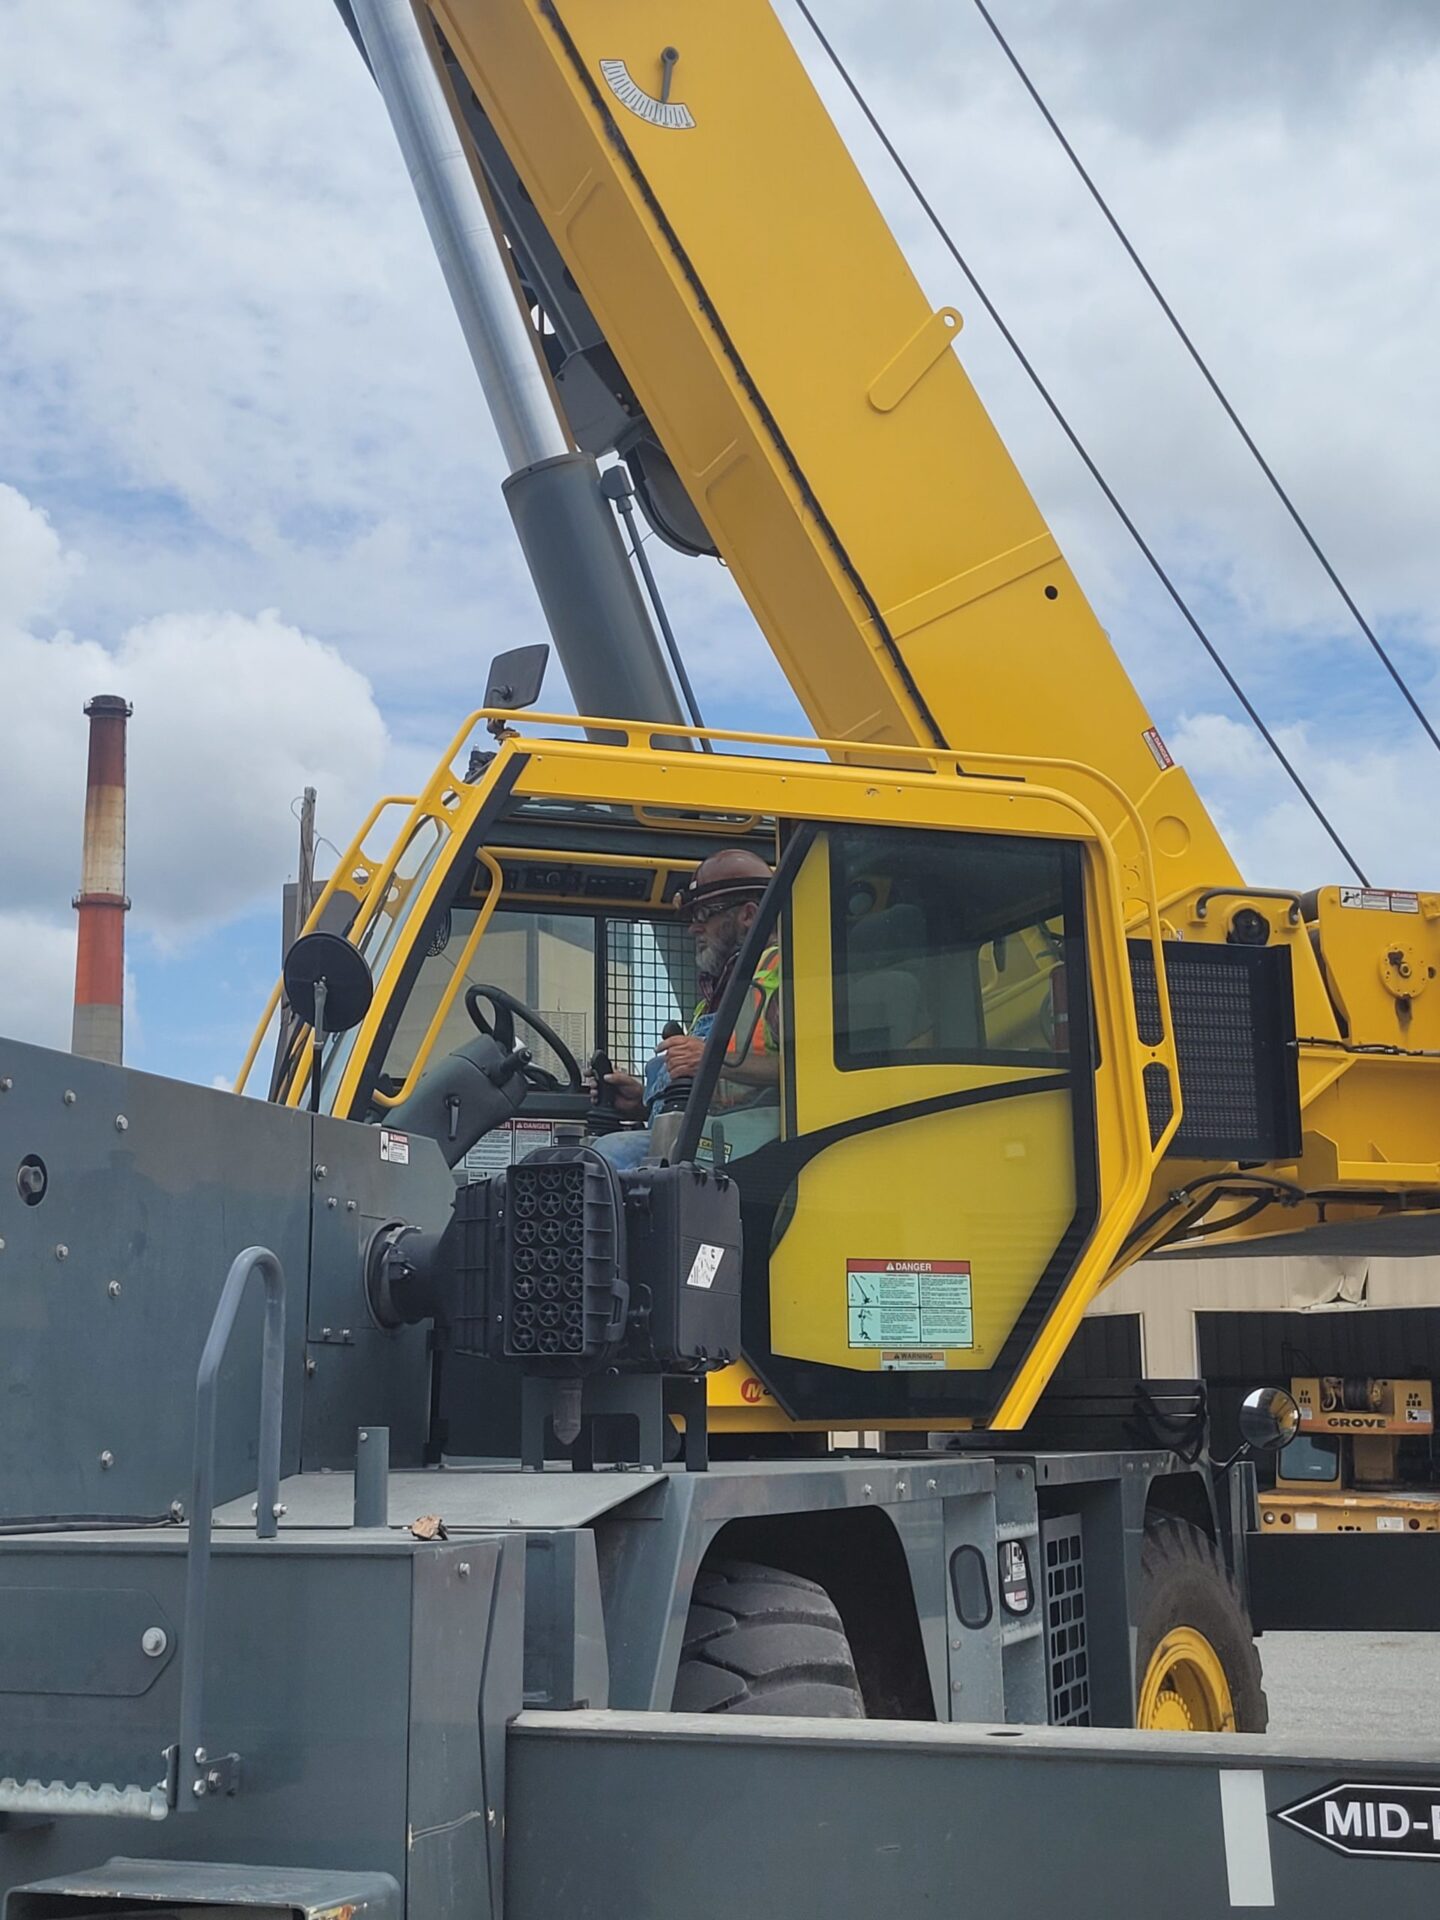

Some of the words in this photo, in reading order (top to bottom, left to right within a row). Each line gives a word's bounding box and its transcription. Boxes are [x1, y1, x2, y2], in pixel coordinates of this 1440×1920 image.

[523, 1122, 551, 1130] DANGER
[895, 1262, 932, 1271] DANGER
[901, 1352, 933, 1360] WARNING
[1327, 1417, 1387, 1428] GROVE
